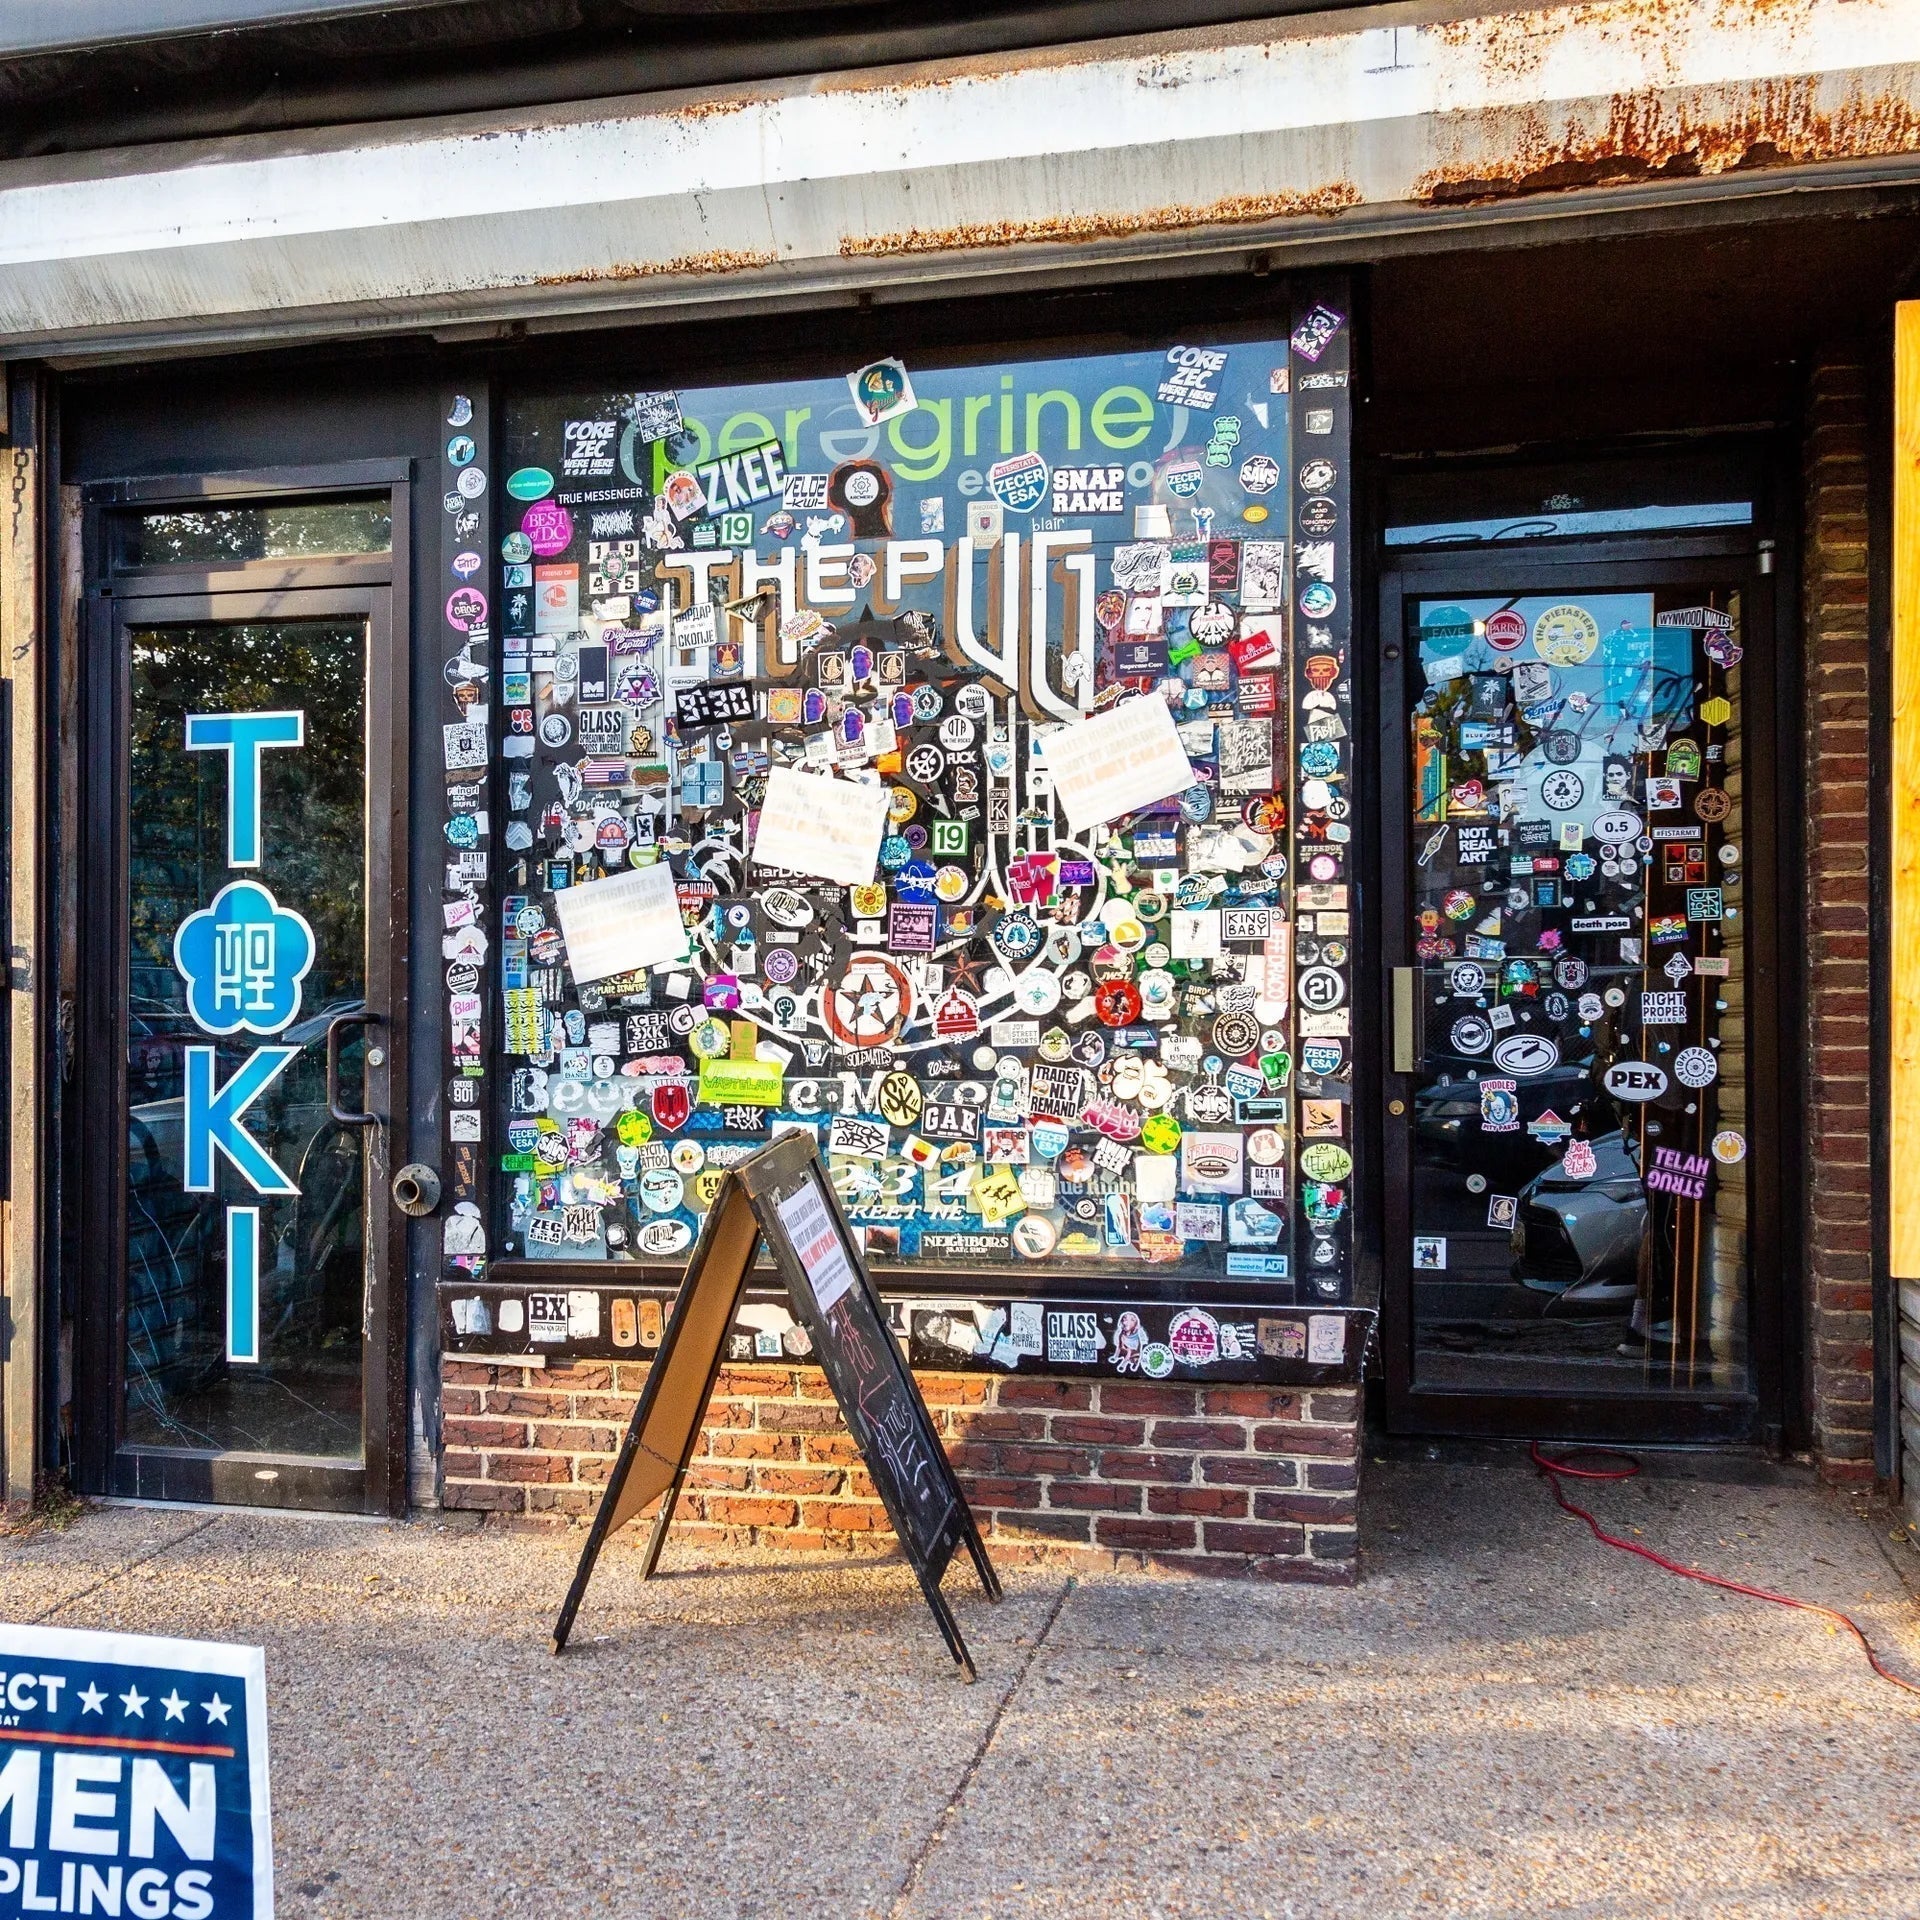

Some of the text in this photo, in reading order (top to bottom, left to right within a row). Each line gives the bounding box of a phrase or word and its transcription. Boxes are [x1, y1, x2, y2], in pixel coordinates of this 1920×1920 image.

[1167, 345, 1228, 371] CORE
[1169, 367, 1213, 389] ZEC
[1157, 383, 1218, 402] WERE HERE
[565, 420, 616, 441] CORE
[571, 439, 607, 459] ZEC
[563, 459, 614, 468] WERE HERE
[698, 441, 784, 517] ZKEE
[995, 471, 1045, 495] ZECER
[1052, 468, 1125, 491] SNAP
[1167, 471, 1202, 485] ZECER
[1175, 481, 1197, 493] ESA
[559, 487, 643, 504] TRUE MESSENGER
[1009, 487, 1040, 505] ESA
[1052, 492, 1124, 513] RAME
[529, 512, 566, 527] BEST
[724, 516, 750, 540] 19
[530, 530, 540, 541] of
[1535, 607, 1596, 643] THE PIETASTERS
[1659, 609, 1731, 628] WYNWOOD WALLS
[1489, 623, 1523, 633] PARISH
[1239, 683, 1271, 695] XXX
[678, 686, 752, 723] 9:30
[580, 710, 621, 733] GLASS
[579, 733, 620, 743] SPREADING COVID
[599, 743, 620, 753] AMERICA
[947, 751, 977, 765] FUCK
[1459, 827, 1489, 839] NOT
[1604, 822, 1629, 833] 0.5
[1655, 829, 1697, 837] #FISTARMY
[936, 825, 964, 847] 19
[1459, 839, 1497, 852] REAL
[463, 854, 484, 863] DEATH
[1459, 852, 1489, 864] ART
[689, 882, 713, 895] ULTRAS
[1228, 912, 1267, 926] KING
[1573, 918, 1628, 931] death pose
[1228, 924, 1267, 937] BABY
[996, 936, 1040, 958] FOREVER
[1309, 977, 1333, 1000] 21
[1643, 993, 1685, 1006] RIGHT
[453, 1000, 478, 1015] Blair
[1643, 1006, 1686, 1017] PROPER
[627, 1014, 667, 1028] ACER
[1221, 1013, 1241, 1025] RIGHT
[1456, 1015, 1474, 1029] MUTUAL
[632, 1025, 669, 1040] 3XK
[1012, 1030, 1038, 1038] STREET
[1012, 1036, 1038, 1044] SPORTS
[846, 1052, 893, 1068] SOLEMATES
[1305, 1048, 1340, 1060] ZECER
[1311, 1059, 1332, 1069] ESA
[1676, 1048, 1716, 1077] RIGHT PROPER
[1036, 1065, 1081, 1085] TRADES
[1227, 1070, 1262, 1090] ZECER
[1611, 1070, 1662, 1090] PEX
[454, 1080, 474, 1088] CHOOSE
[703, 1075, 780, 1092] WASTELAND
[1231, 1083, 1253, 1097] ESA
[1481, 1080, 1517, 1092] PUDDLES
[453, 1088, 474, 1103] 901
[1030, 1096, 1077, 1118] REMAND
[1482, 1122, 1520, 1131] PITY PARTY
[510, 1130, 538, 1140] ZECER
[515, 1139, 534, 1149] ESA
[1655, 1146, 1710, 1177] TELAH
[1255, 1169, 1280, 1178] DEATH
[533, 1217, 562, 1231] ZEC
[531, 1226, 562, 1237] ESA
[529, 1233, 560, 1245] CREW
[923, 1234, 1009, 1249] NEIGHBORS
[1265, 1260, 1284, 1272] ADT
[530, 1296, 567, 1321] BX
[1049, 1315, 1096, 1338] GLASS
[1012, 1340, 1040, 1348] PICTURES
[1049, 1338, 1096, 1350] SPREADING COVID
[1048, 1350, 1096, 1361] ACROSS AMERICA
